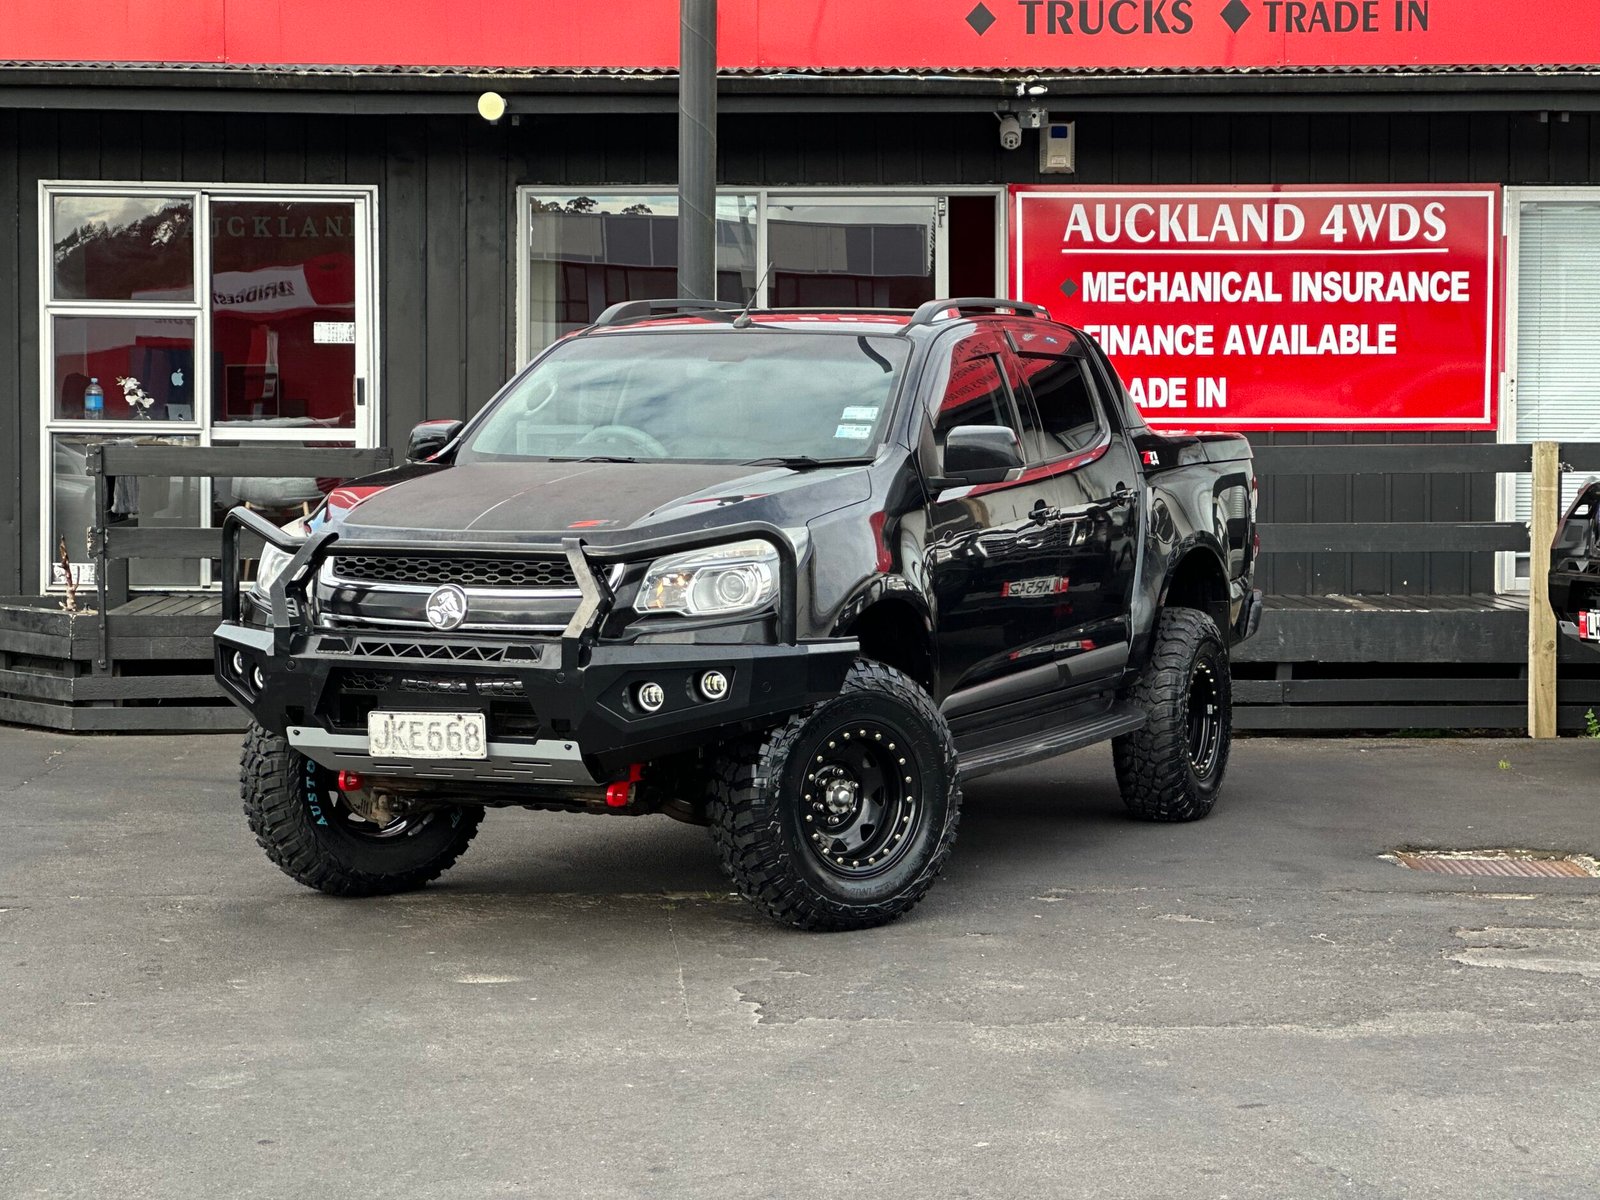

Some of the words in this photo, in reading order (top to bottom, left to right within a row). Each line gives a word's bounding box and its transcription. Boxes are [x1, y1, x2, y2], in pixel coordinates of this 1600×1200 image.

[1018, 0, 1193, 35] TRUCKS
[1263, 1, 1379, 33] TRADE
[1395, 1, 1429, 32] IN
[181, 216, 355, 238] AUCKLAN
[1063, 203, 1306, 243] AUCKLAND
[1320, 202, 1447, 243] 4WDS
[1082, 271, 1282, 302] MECHANICAL
[1292, 271, 1470, 302] INSURANCE
[1084, 324, 1214, 355] FINANCE
[1223, 324, 1397, 355] AVAILABLE
[1197, 377, 1227, 408] IN
[375, 720, 480, 752] JKE668
